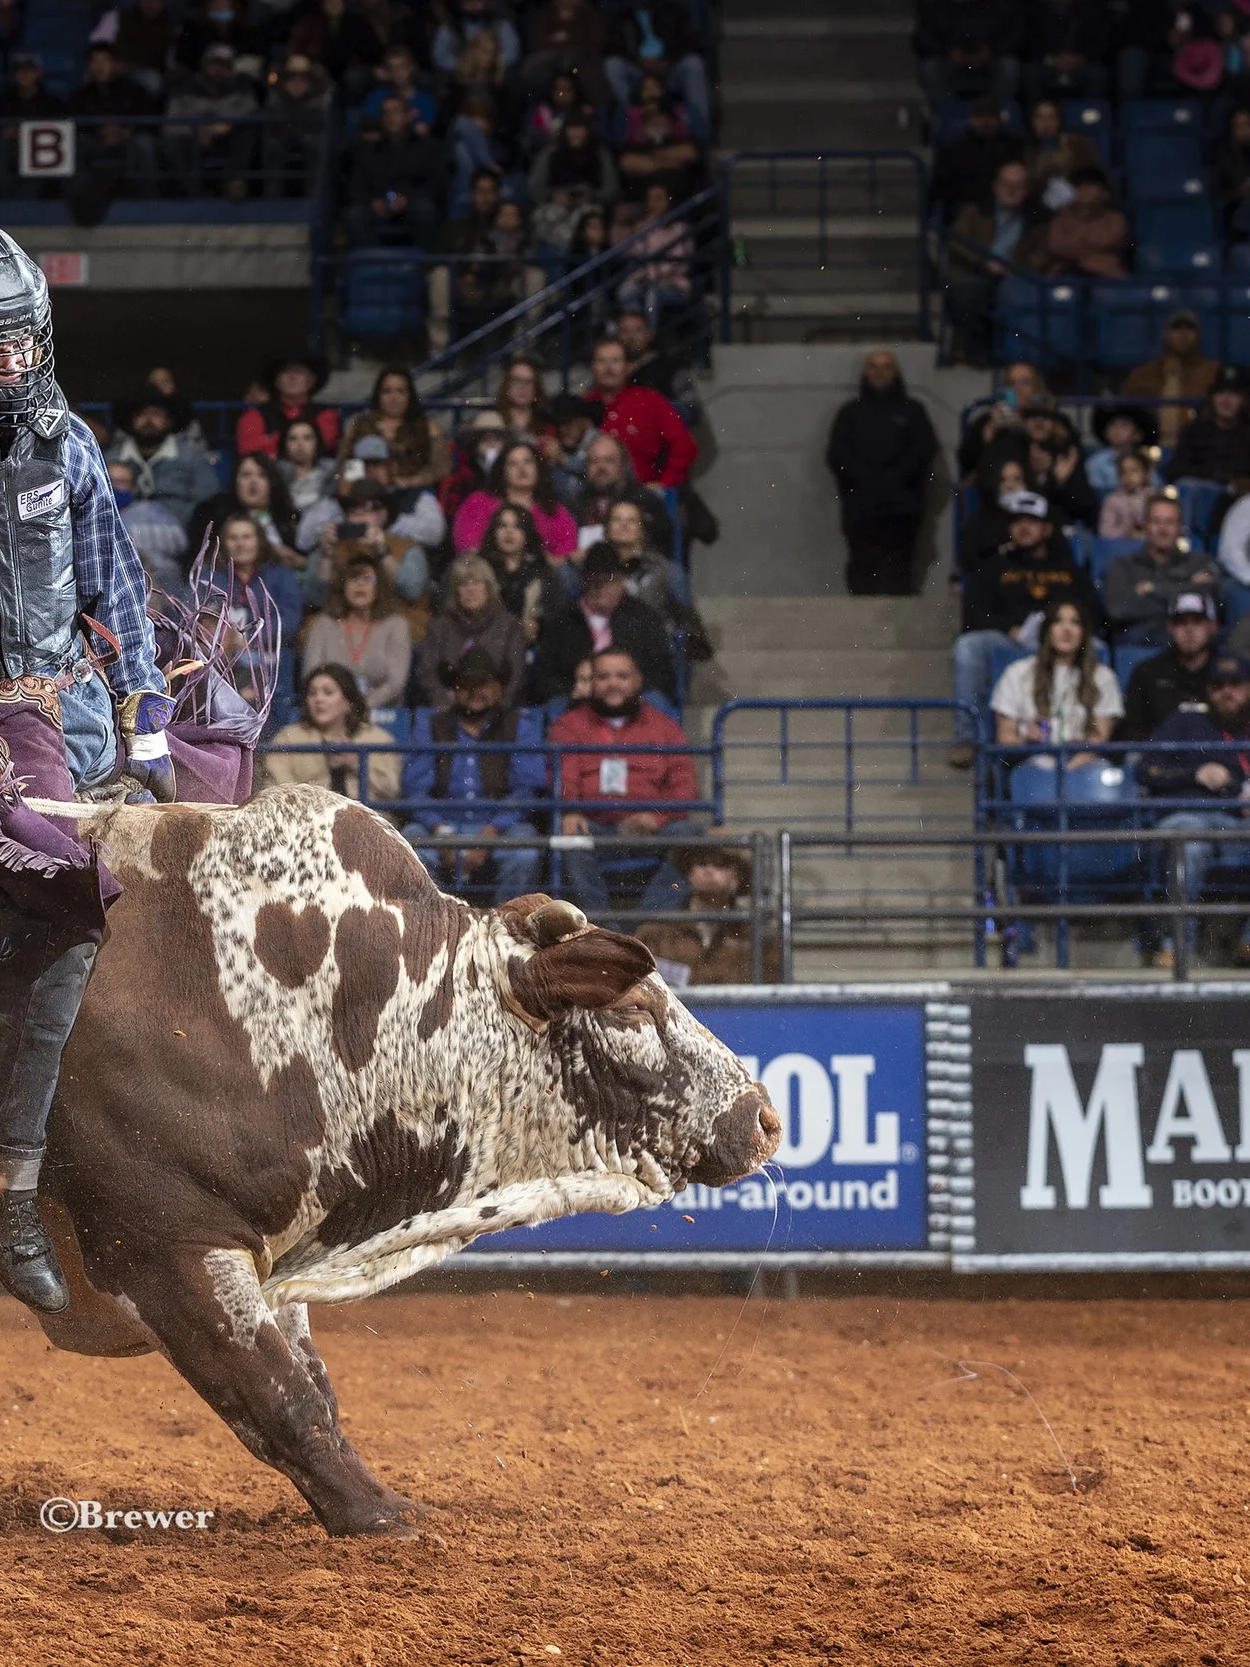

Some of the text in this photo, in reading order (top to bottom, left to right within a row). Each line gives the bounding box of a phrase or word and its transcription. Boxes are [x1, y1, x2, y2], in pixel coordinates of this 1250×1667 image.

[30, 127, 63, 170] B
[20, 490, 39, 505] ERS
[26, 497, 53, 512] Gunite
